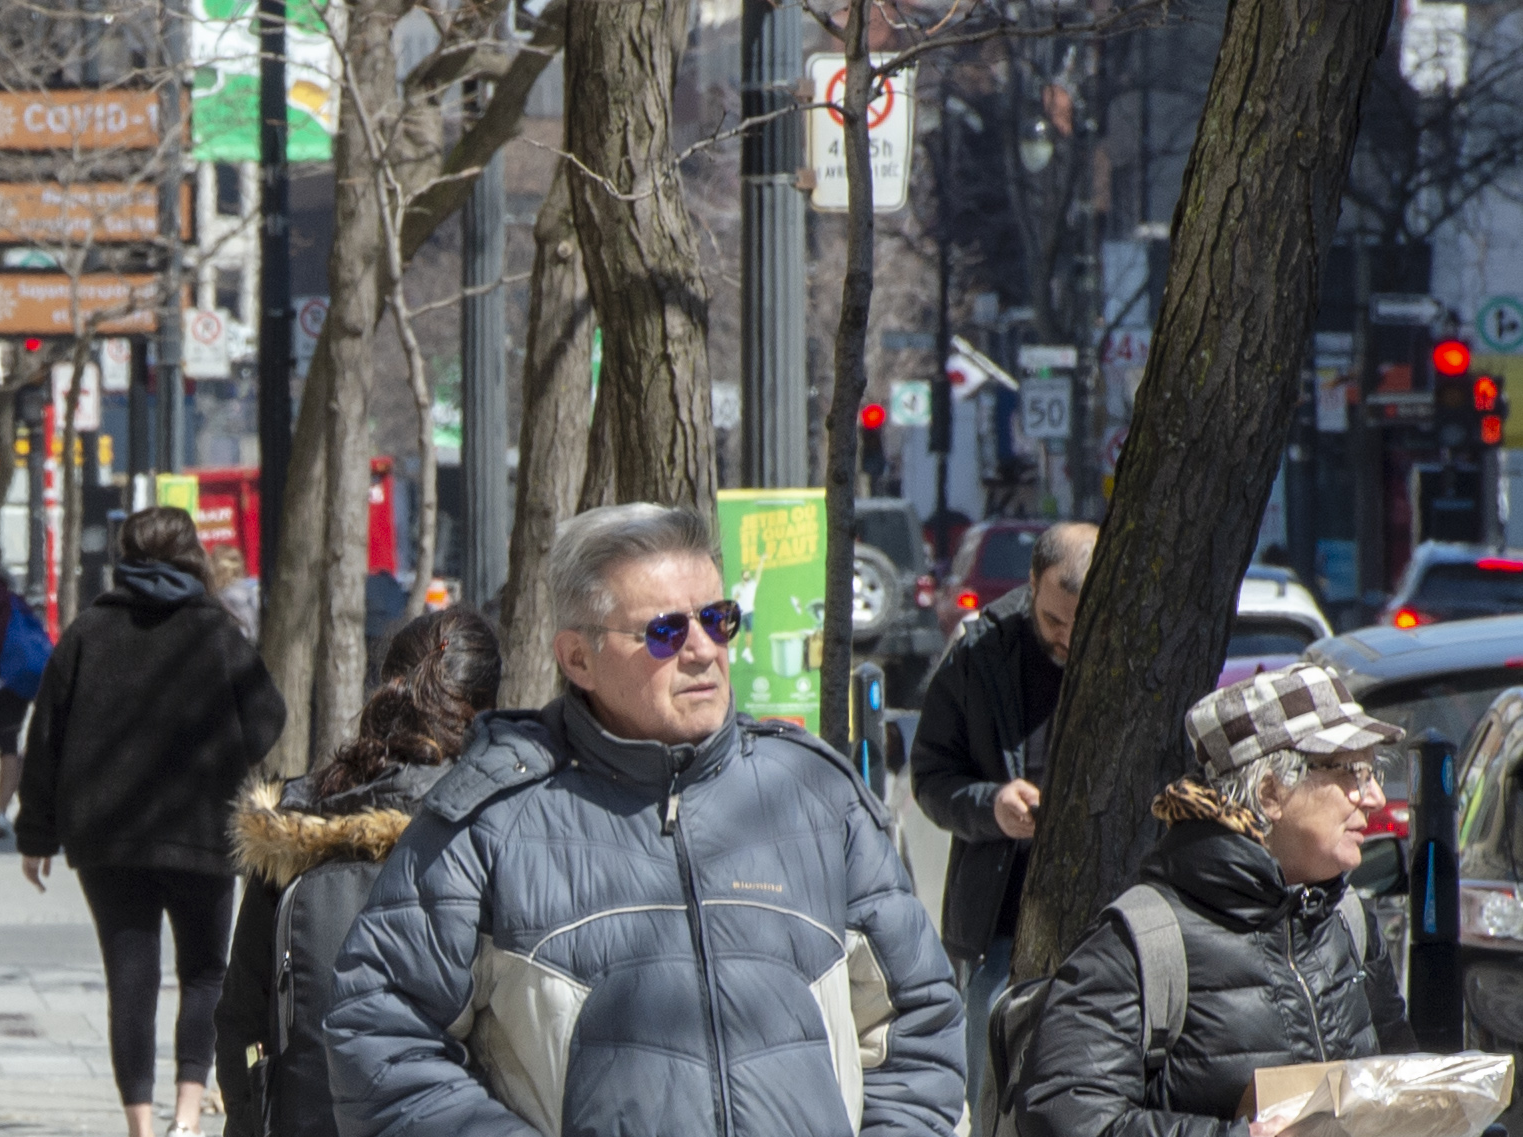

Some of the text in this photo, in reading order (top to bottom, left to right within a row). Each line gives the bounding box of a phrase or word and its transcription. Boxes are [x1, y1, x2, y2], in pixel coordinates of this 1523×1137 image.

[24, 102, 159, 134] COVID-1
[1029, 399, 1064, 429] 50
[765, 533, 819, 561] FAUT
